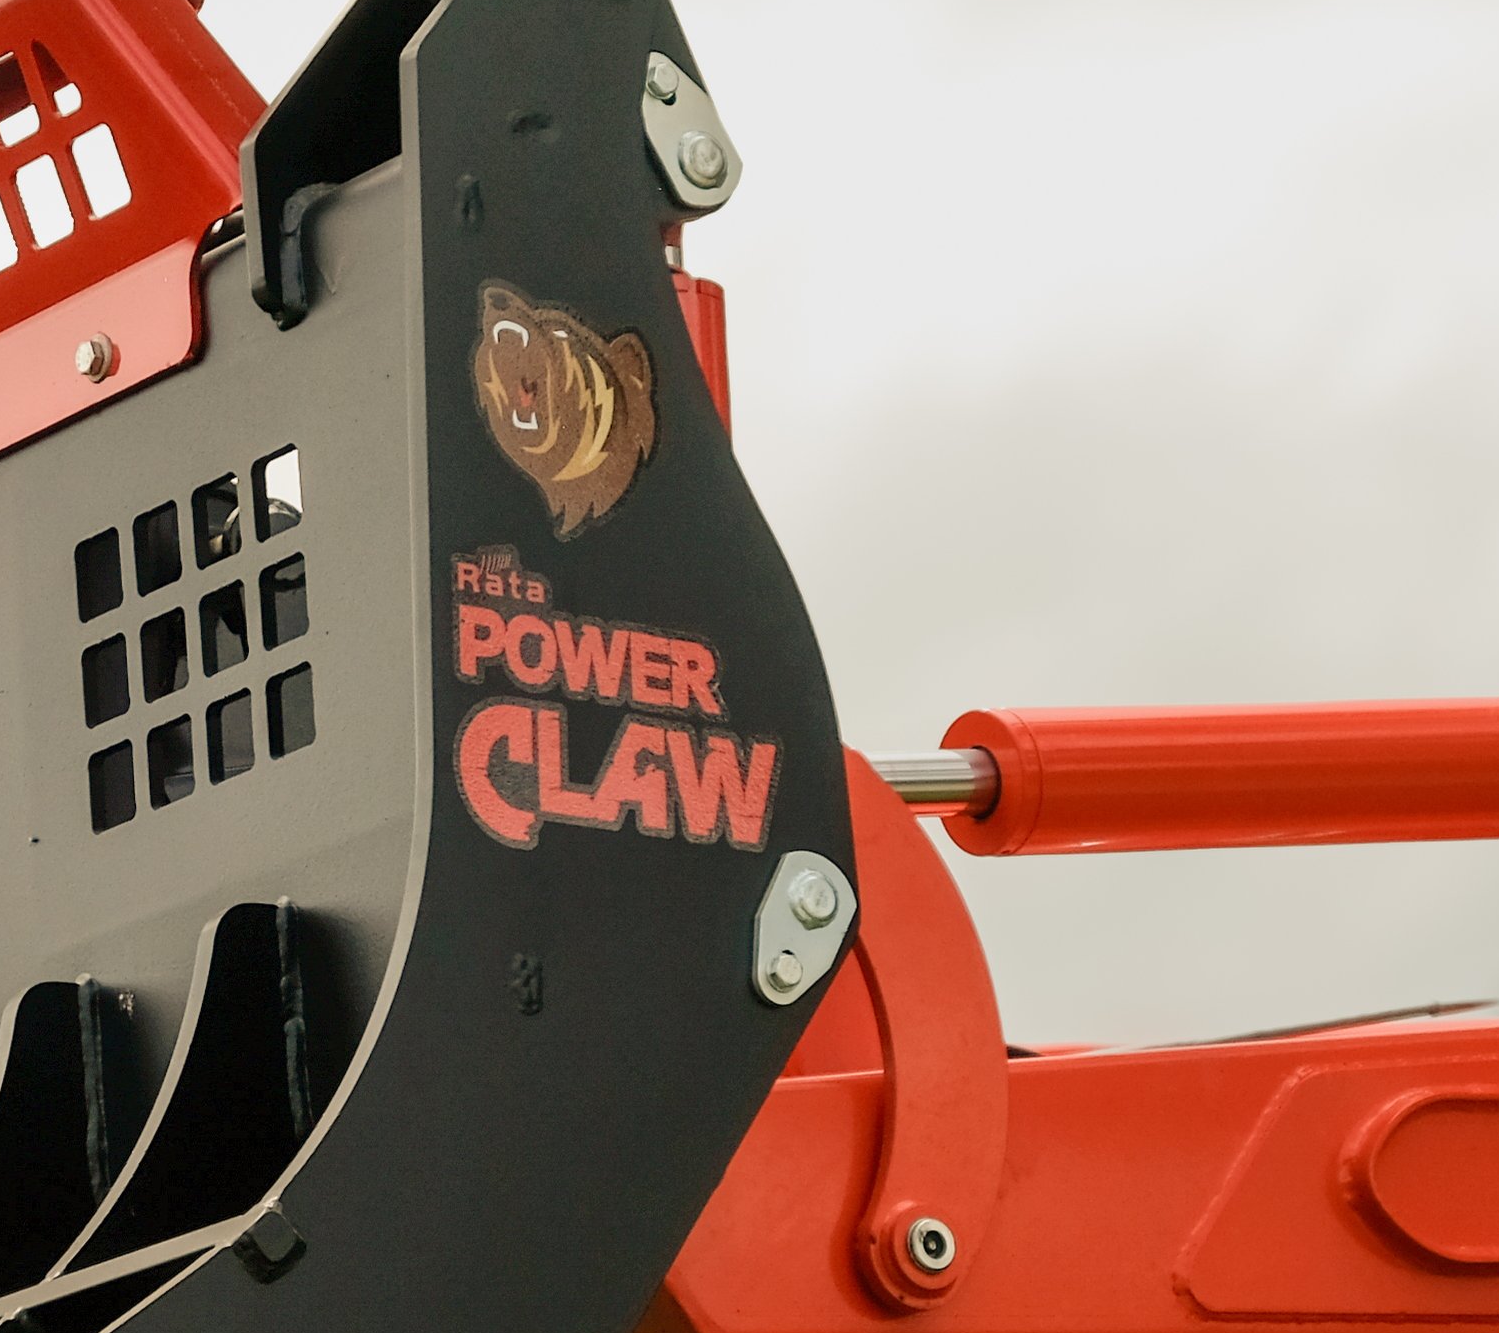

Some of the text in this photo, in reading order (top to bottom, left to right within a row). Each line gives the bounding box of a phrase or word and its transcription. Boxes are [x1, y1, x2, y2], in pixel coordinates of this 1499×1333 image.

[457, 562, 545, 603] Rata
[459, 604, 721, 715] POWER
[459, 704, 777, 844] CLAW
